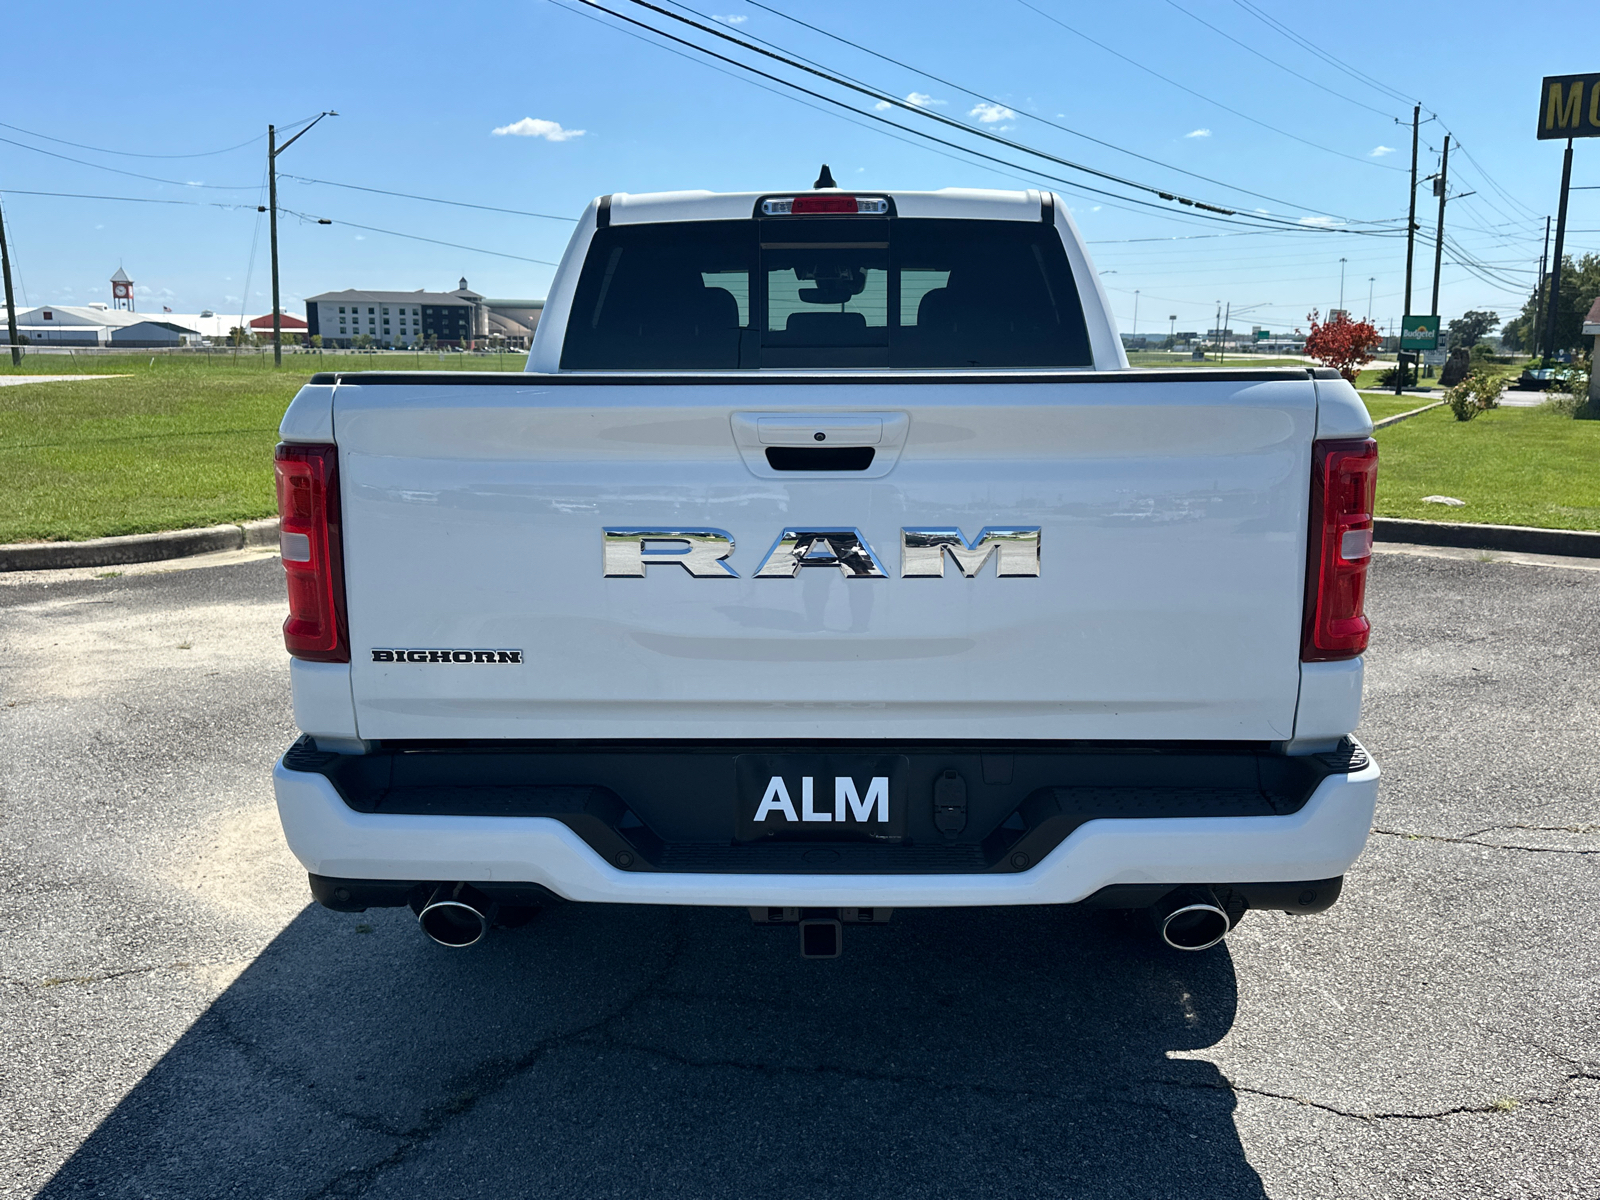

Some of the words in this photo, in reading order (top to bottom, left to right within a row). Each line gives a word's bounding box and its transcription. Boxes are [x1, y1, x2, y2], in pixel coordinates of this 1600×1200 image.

[1403, 329, 1435, 340] Budgetel
[602, 526, 1042, 579] RAM
[371, 649, 523, 664] BIGHORN
[753, 776, 889, 823] ALM
